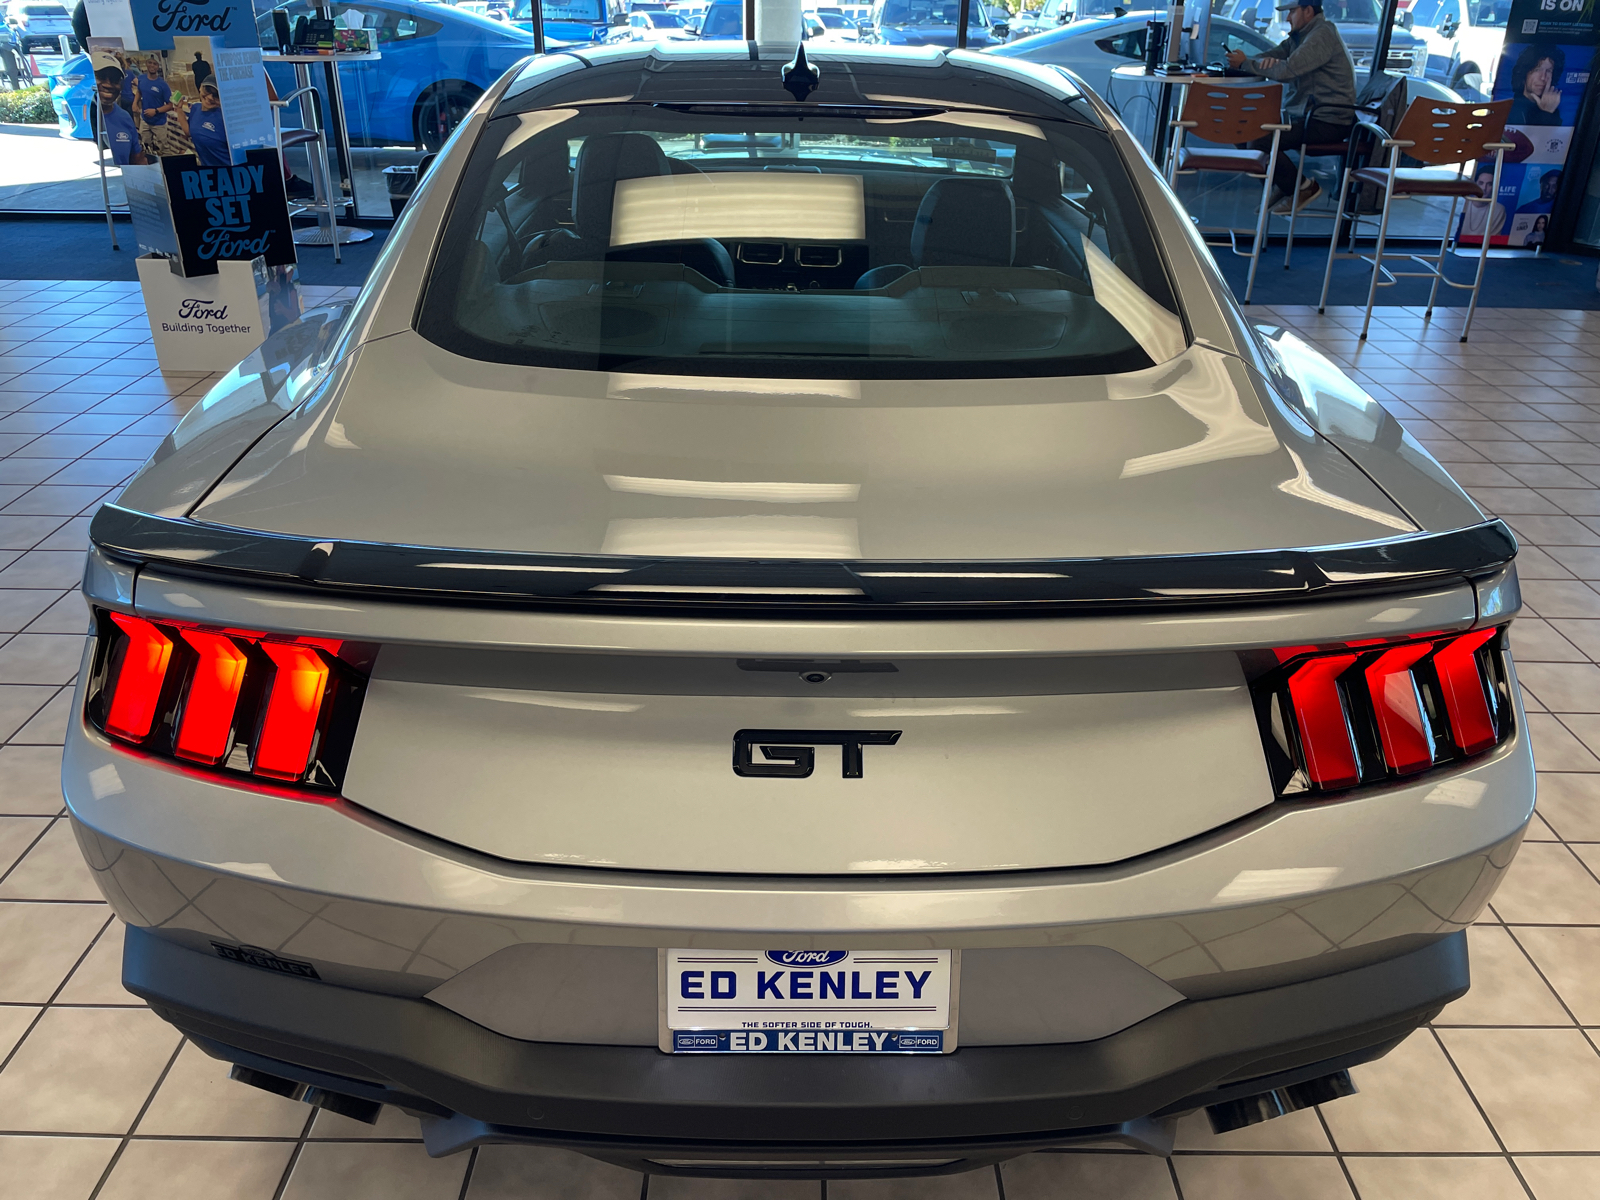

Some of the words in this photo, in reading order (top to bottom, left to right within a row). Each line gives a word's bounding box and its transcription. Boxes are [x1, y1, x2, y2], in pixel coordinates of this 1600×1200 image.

[152, 0, 232, 32] Ford
[1540, 0, 1557, 11] IS
[1559, 0, 1585, 12] ON
[180, 164, 264, 200] READY
[205, 194, 252, 227] SET
[197, 225, 271, 260] Ford
[178, 299, 229, 320] Ford
[162, 322, 204, 334] Building
[206, 323, 251, 335] Together
[732, 728, 903, 779] GT
[241, 953, 313, 976] KENLEY
[782, 949, 831, 963] Ford
[680, 970, 737, 1000] ED
[756, 970, 933, 1000] KENLEY
[731, 1032, 768, 1051] ED
[778, 1032, 889, 1051] KENLEY
